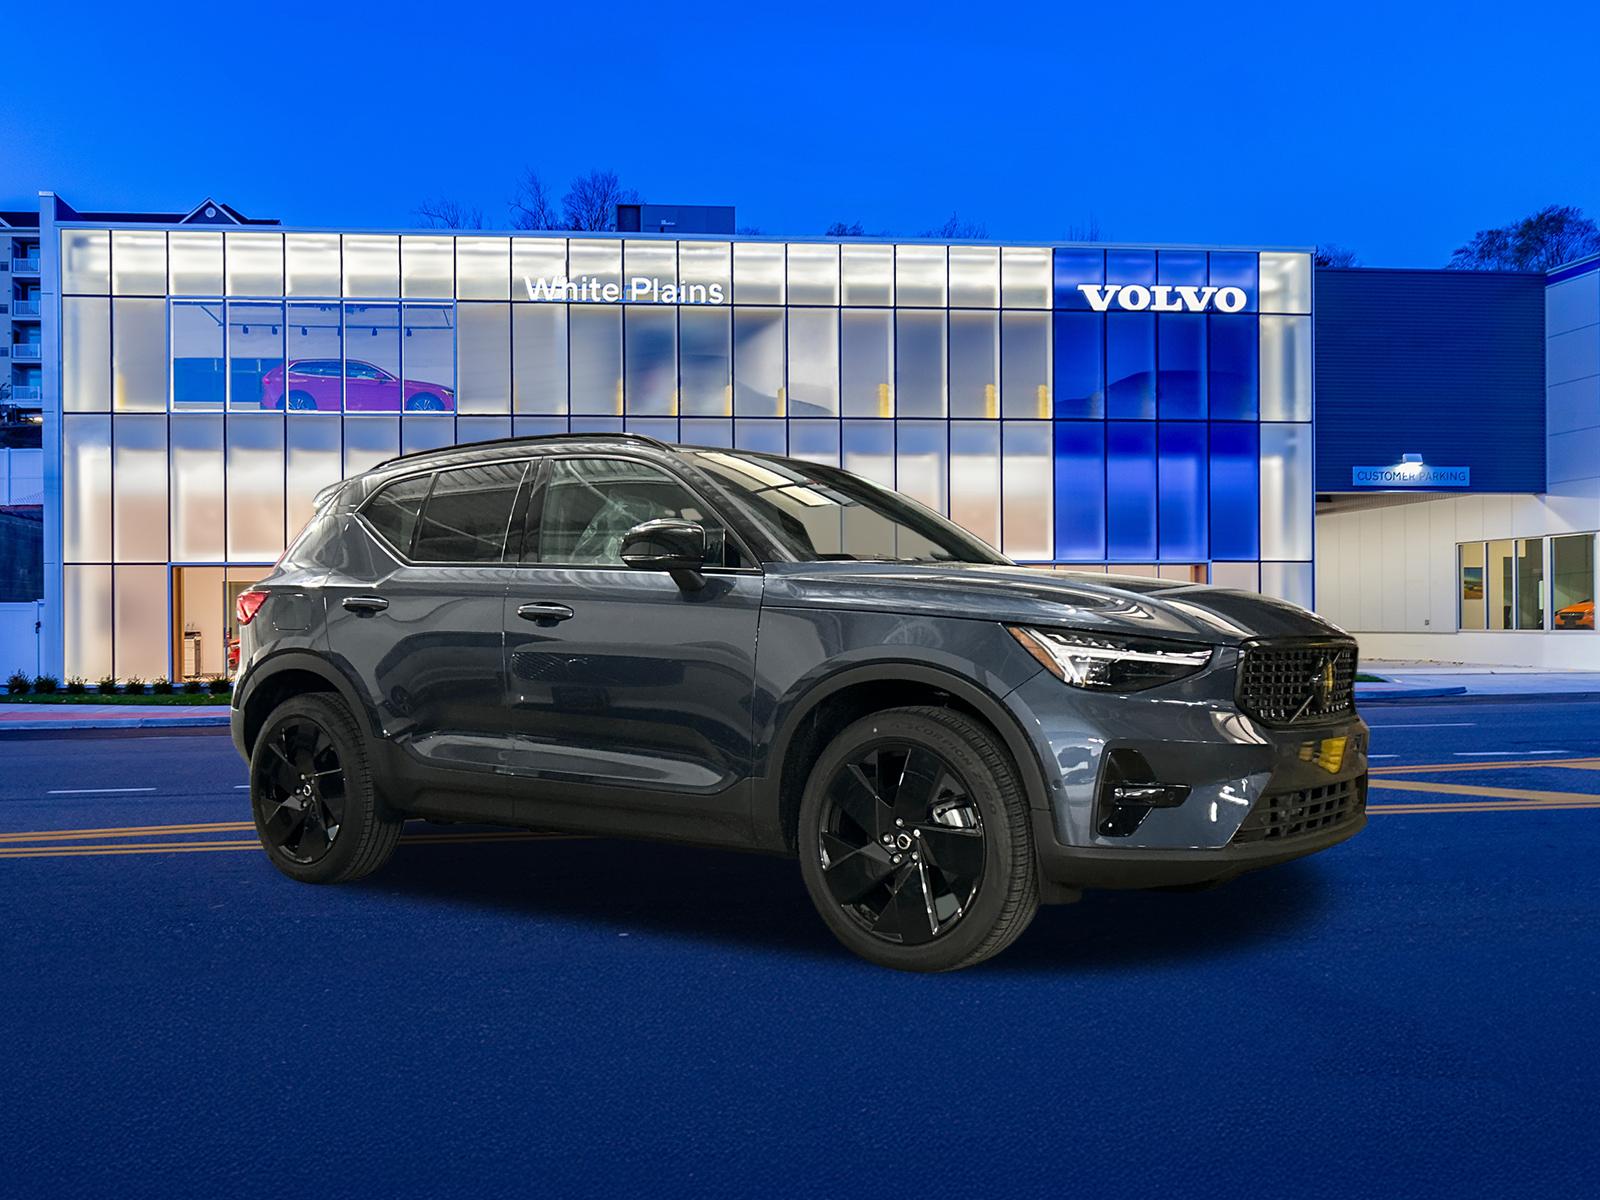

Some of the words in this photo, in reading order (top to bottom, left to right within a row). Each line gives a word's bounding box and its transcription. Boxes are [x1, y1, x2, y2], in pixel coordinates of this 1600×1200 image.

[524, 275, 619, 301] White
[631, 277, 724, 303] Plains
[1077, 284, 1247, 312] VOLVO
[1357, 471, 1416, 481] CUSTOMER
[1419, 471, 1466, 481] PARKING
